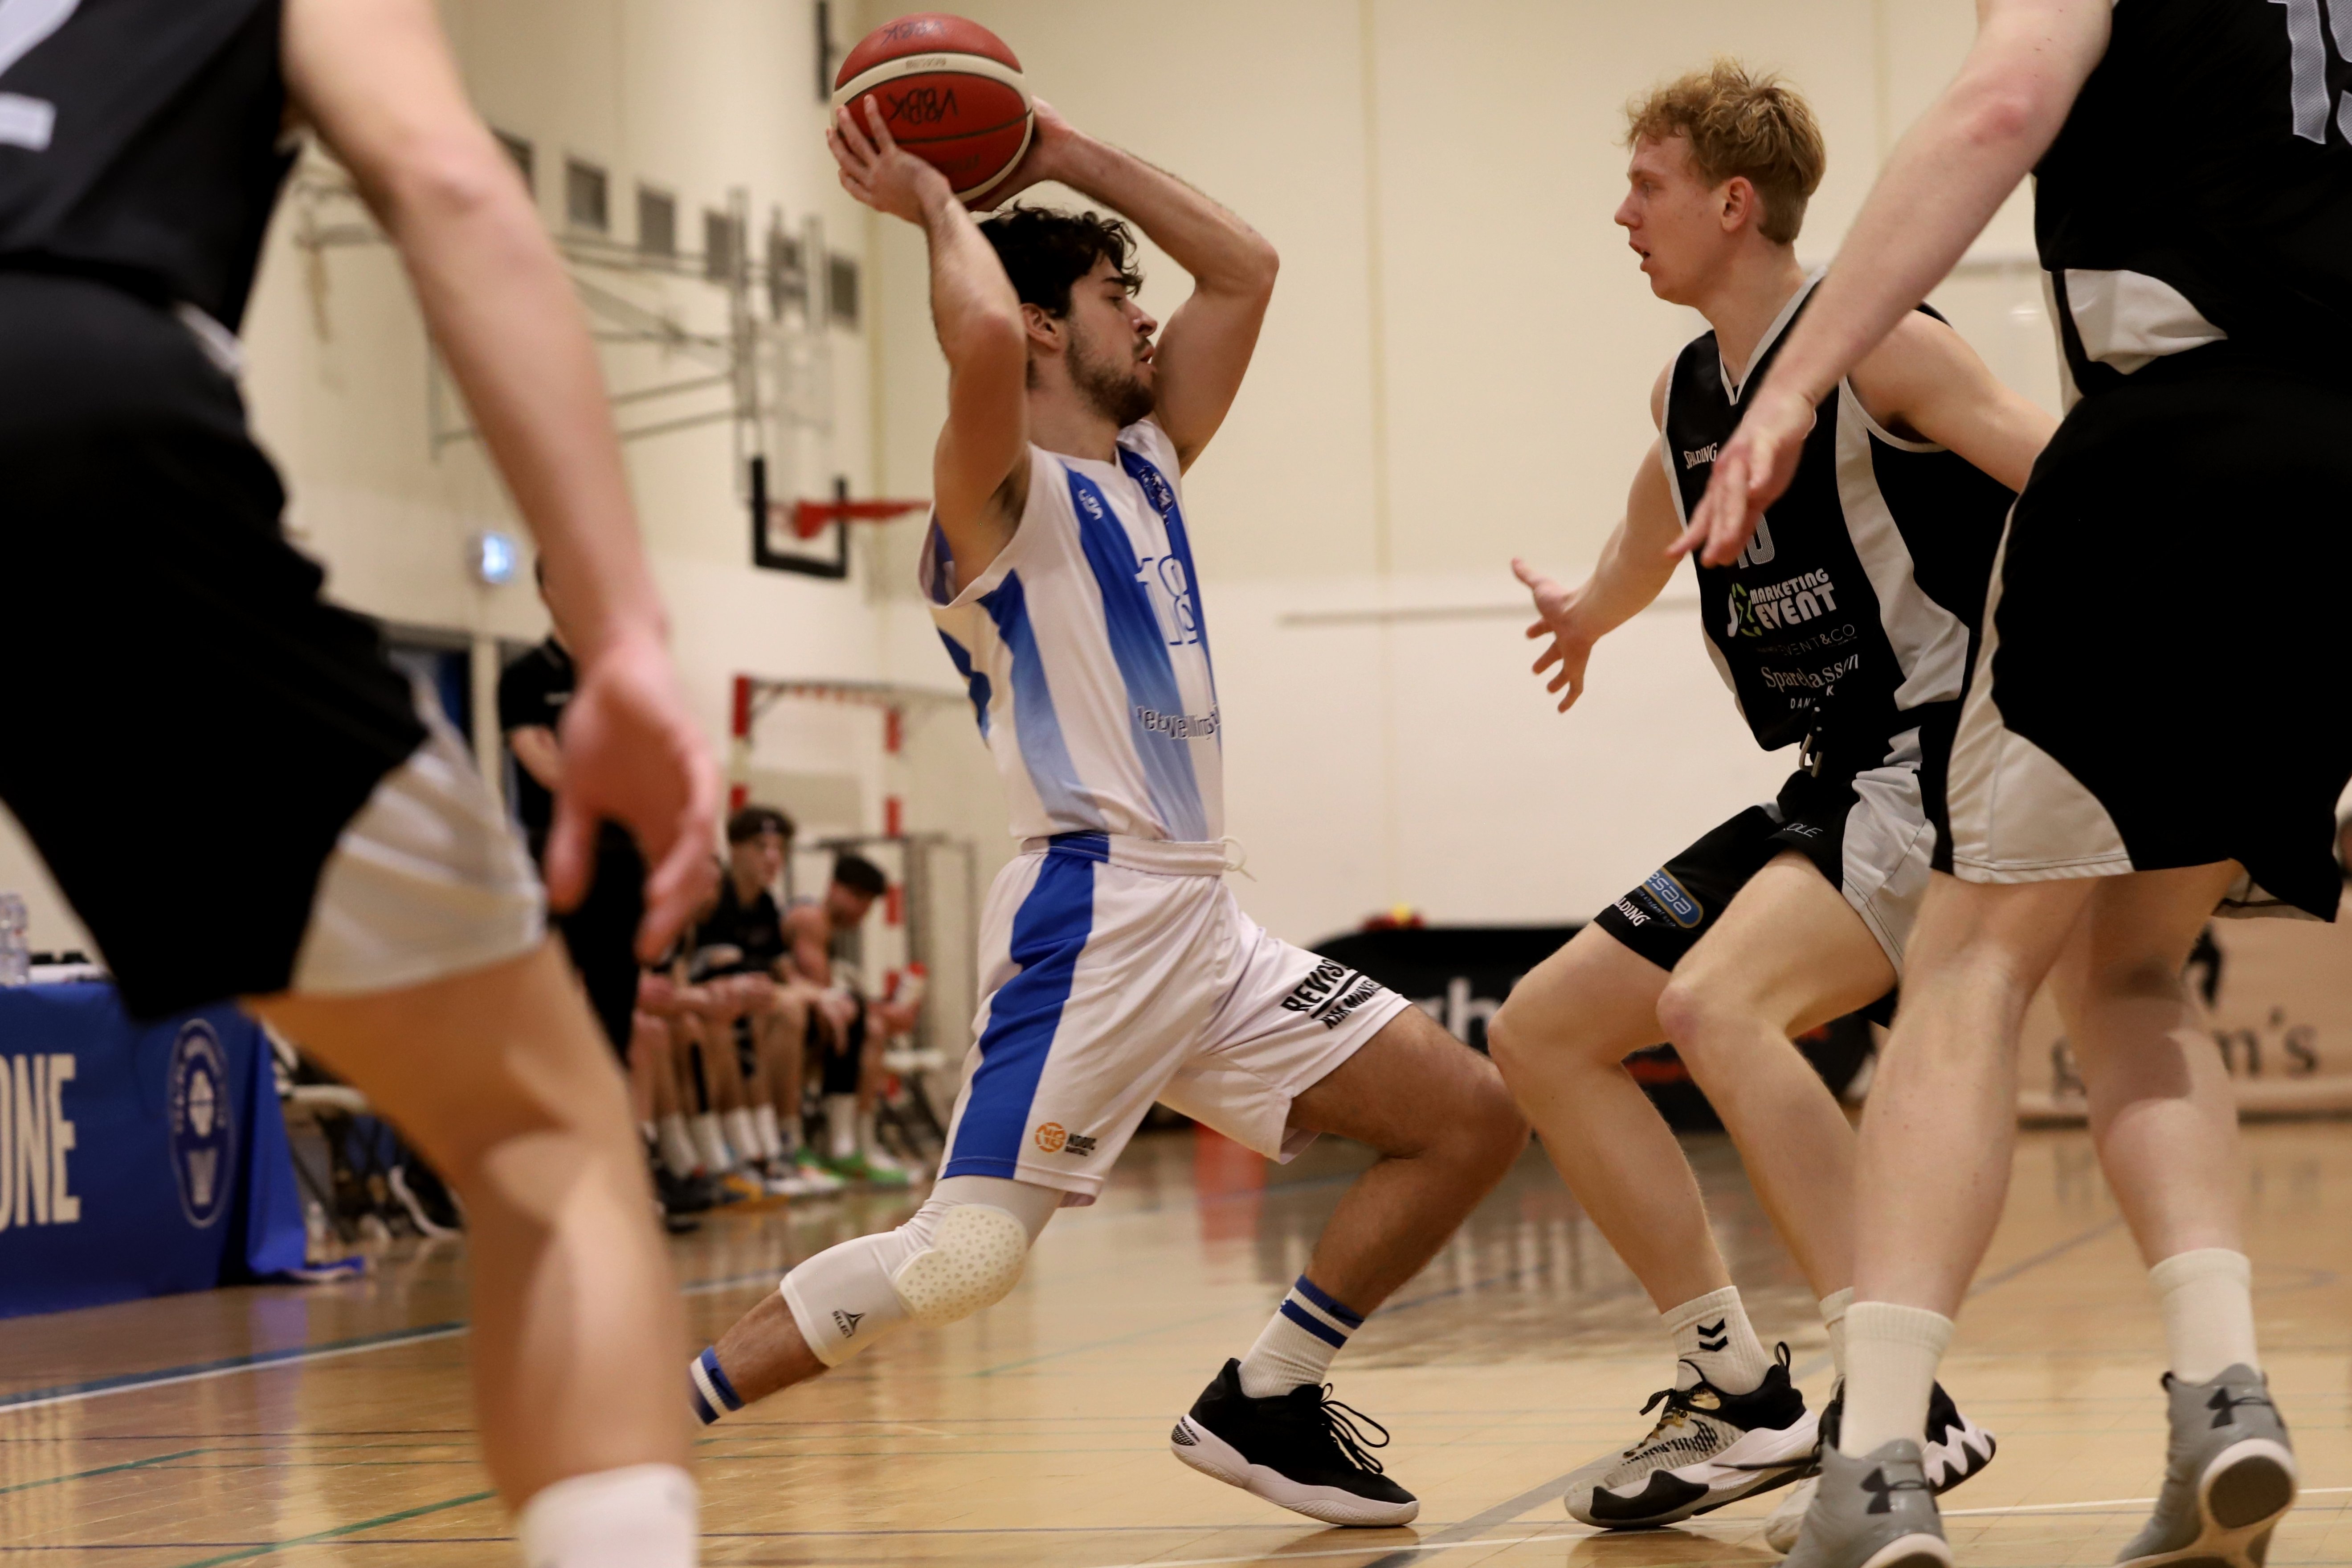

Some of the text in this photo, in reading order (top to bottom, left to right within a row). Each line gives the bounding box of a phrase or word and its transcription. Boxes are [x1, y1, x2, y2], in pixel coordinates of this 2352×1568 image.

[1684, 442, 1718, 470] SPALDING
[1737, 512, 1775, 569] 0
[1135, 554, 1199, 645] 18
[1750, 568, 1829, 604] MARKETING
[1755, 582, 1837, 629] EVENT
[1790, 685, 1834, 709] DANK
[1280, 959, 1351, 1012] REVIS
